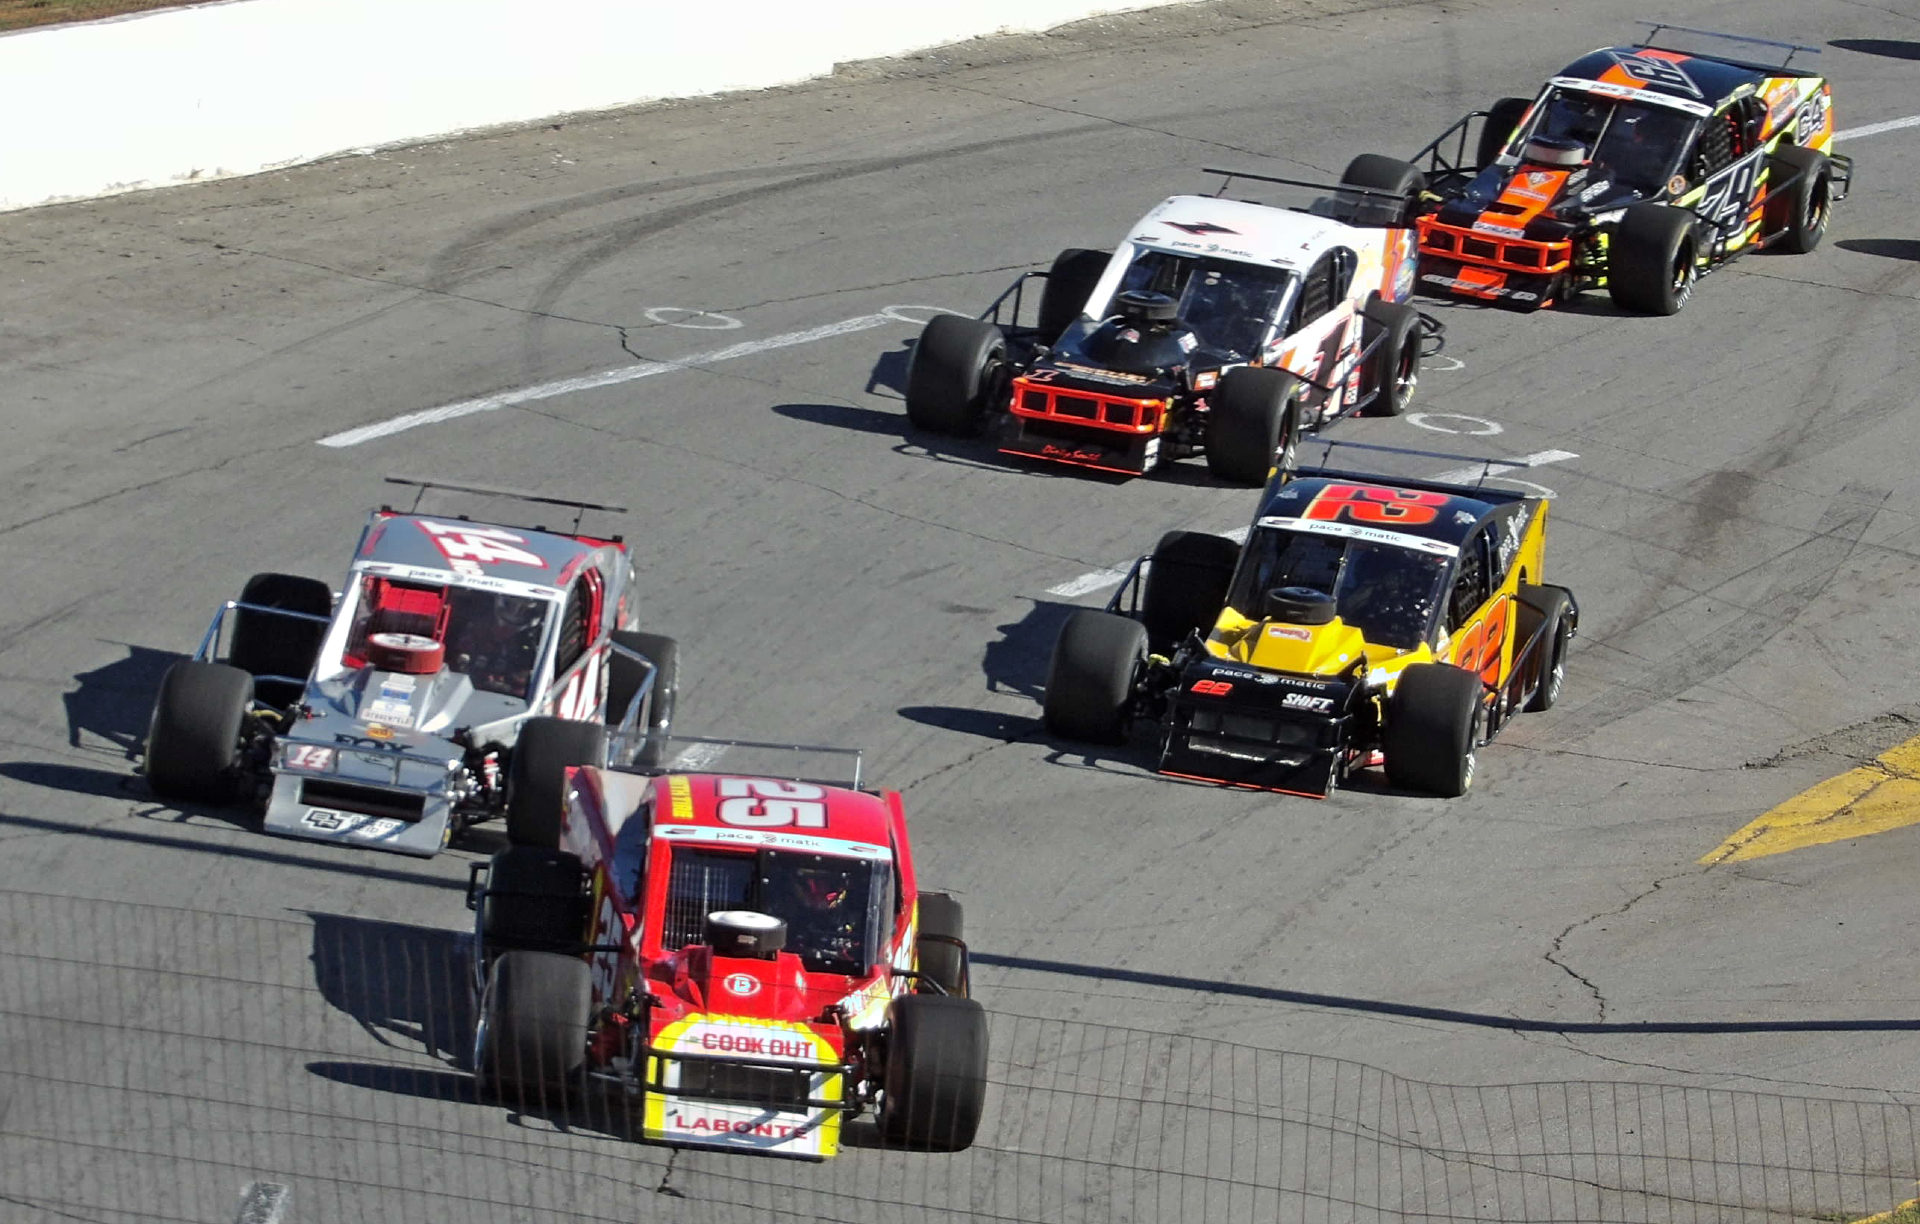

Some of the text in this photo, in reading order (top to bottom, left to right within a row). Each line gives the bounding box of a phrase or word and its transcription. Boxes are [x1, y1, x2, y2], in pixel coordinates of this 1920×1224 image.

[1171, 240, 1255, 258] pace matic
[1300, 484, 1452, 526] 22
[1309, 522, 1402, 542] pace matic
[412, 519, 549, 570] 14
[409, 569, 506, 589] pace matic
[1190, 679, 1233, 697] 22
[1211, 667, 1326, 690] pace matic
[287, 745, 333, 770] 14
[714, 778, 831, 829] 25
[714, 831, 823, 848] pace matic
[702, 1033, 813, 1059] COOK OUT
[675, 1115, 808, 1140] LABONTE
